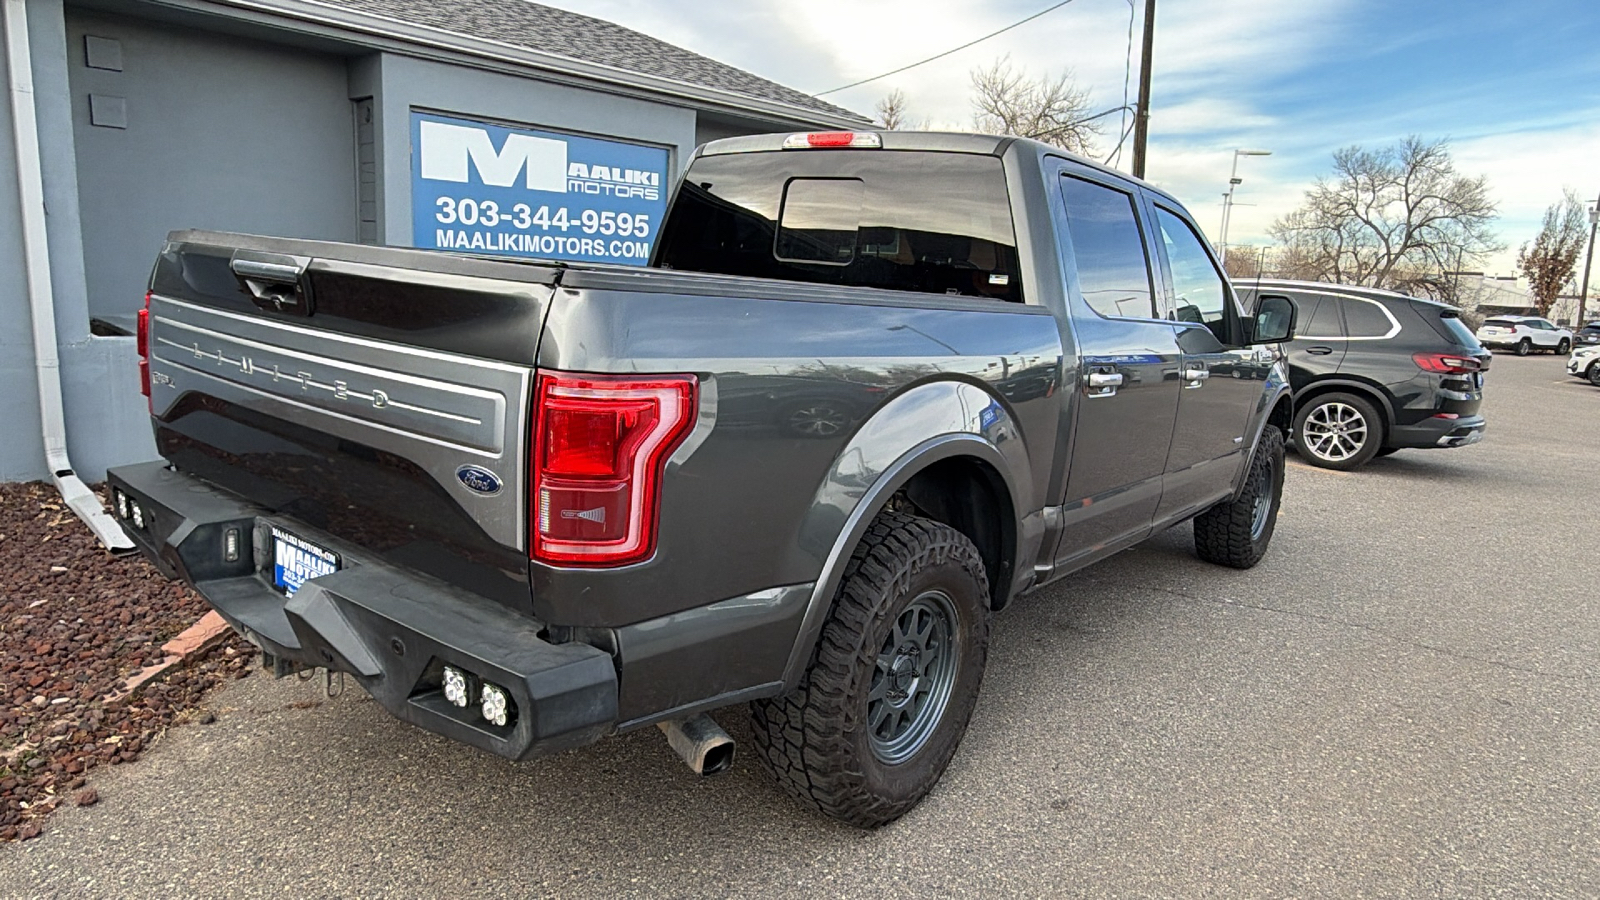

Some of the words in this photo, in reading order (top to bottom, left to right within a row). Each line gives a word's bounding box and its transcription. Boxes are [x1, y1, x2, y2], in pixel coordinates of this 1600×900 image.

[568, 181, 659, 200] MOTORS
[435, 196, 650, 238] 303-344-9595
[436, 229, 649, 259] MAALIKIMOTORS.COM
[193, 342, 389, 409] LIMITED
[464, 470, 491, 491] Ford
